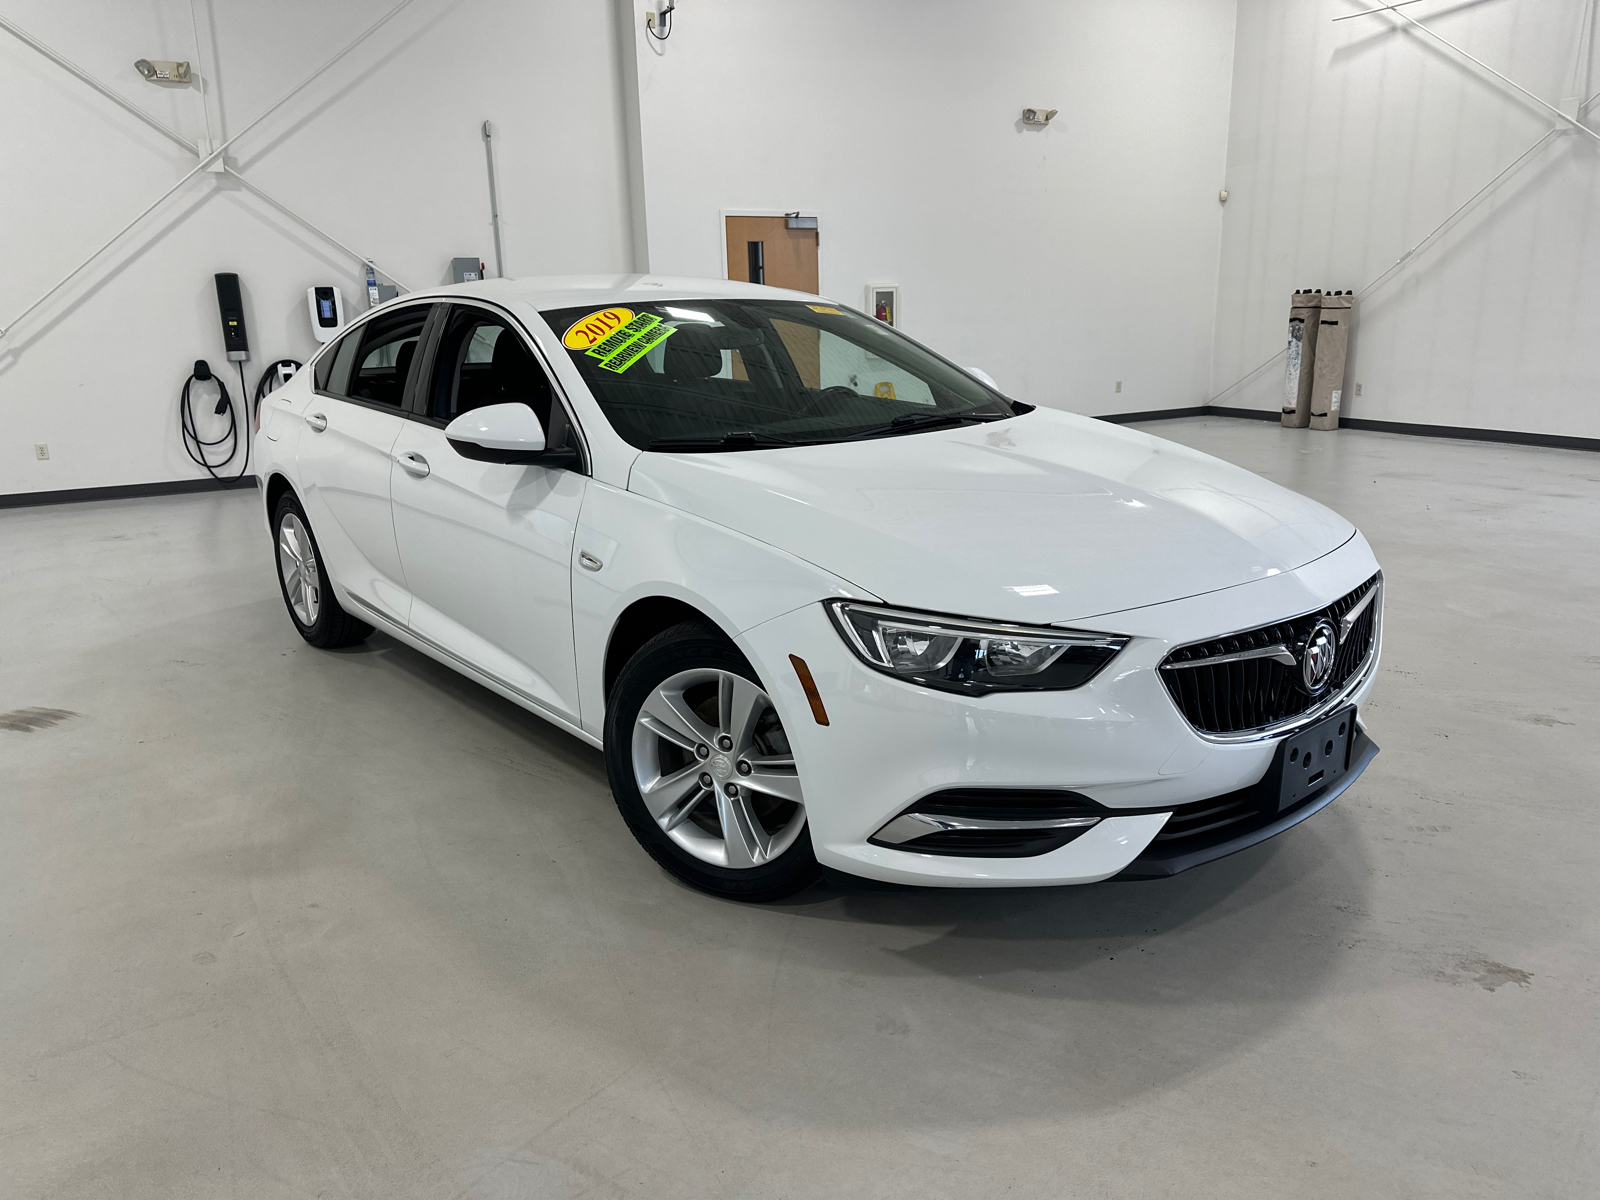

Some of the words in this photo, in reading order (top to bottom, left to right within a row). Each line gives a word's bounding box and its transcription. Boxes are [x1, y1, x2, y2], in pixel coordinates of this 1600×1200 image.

[575, 311, 621, 344] 2019
[590, 329, 635, 358] REMOTE
[624, 313, 658, 333] START
[603, 341, 647, 370] REARVIEW
[636, 323, 671, 345] CAMERA
